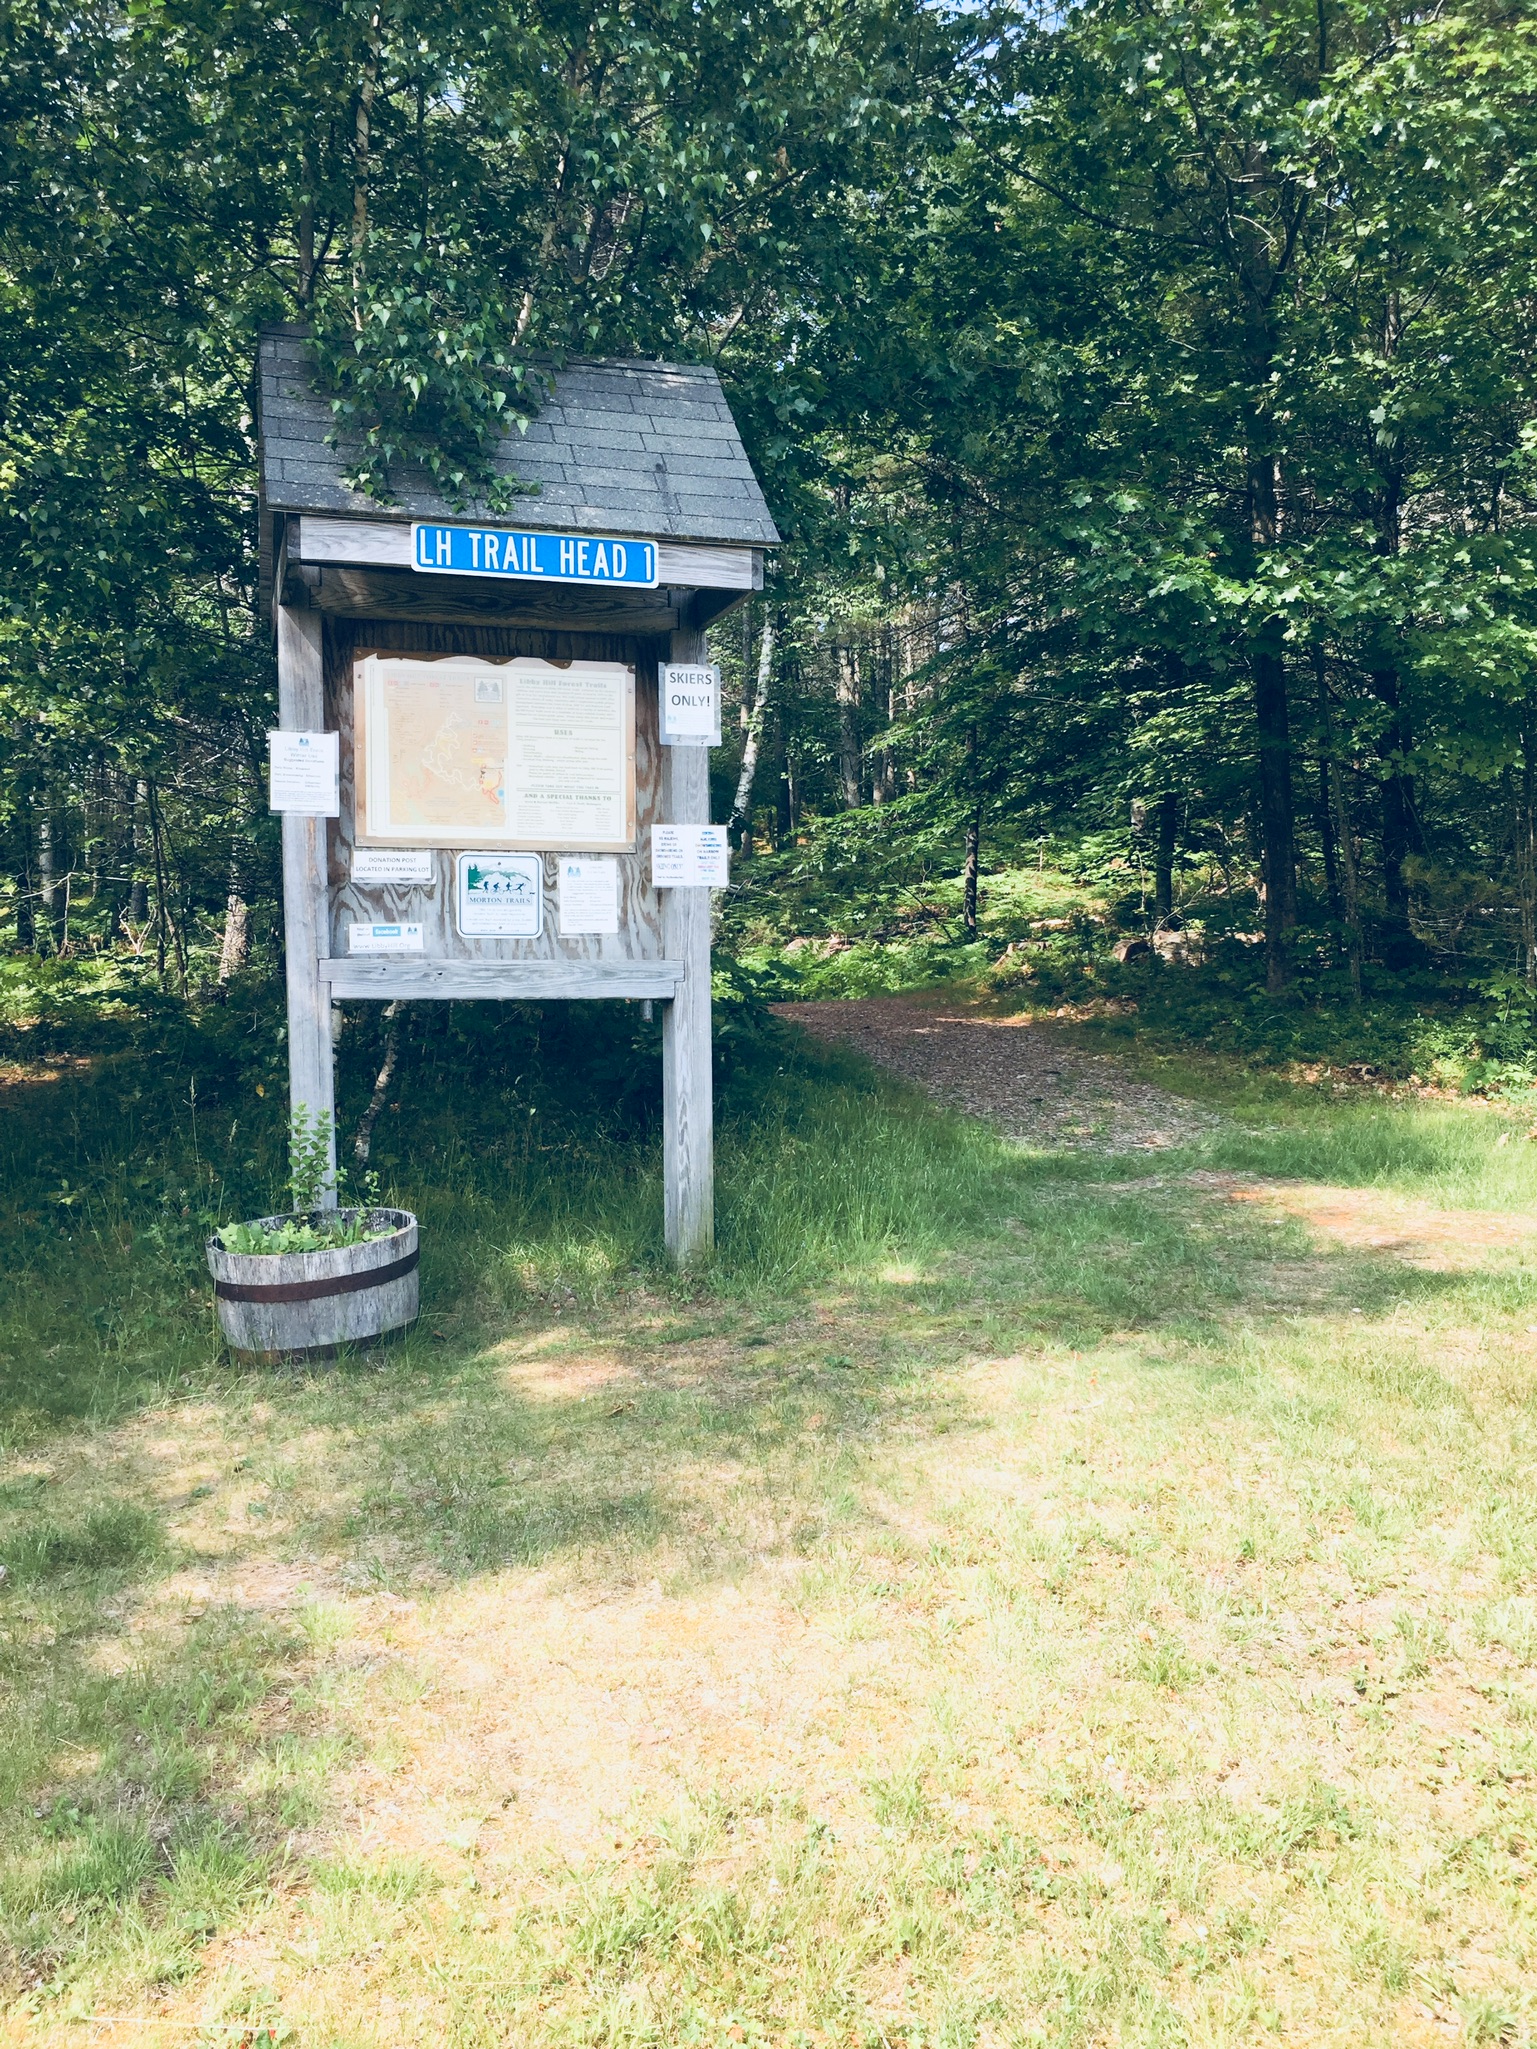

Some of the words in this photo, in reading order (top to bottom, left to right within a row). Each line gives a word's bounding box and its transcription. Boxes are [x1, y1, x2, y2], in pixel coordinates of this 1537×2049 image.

[419, 528, 452, 566] LH
[468, 532, 544, 573] TRAIL
[560, 539, 627, 578] HEAD
[643, 546, 651, 580] 1
[558, 680, 583, 688] Forest
[669, 672, 712, 685] SKIERS
[671, 694, 710, 707] ONLY!
[469, 896, 502, 904] MORTON
